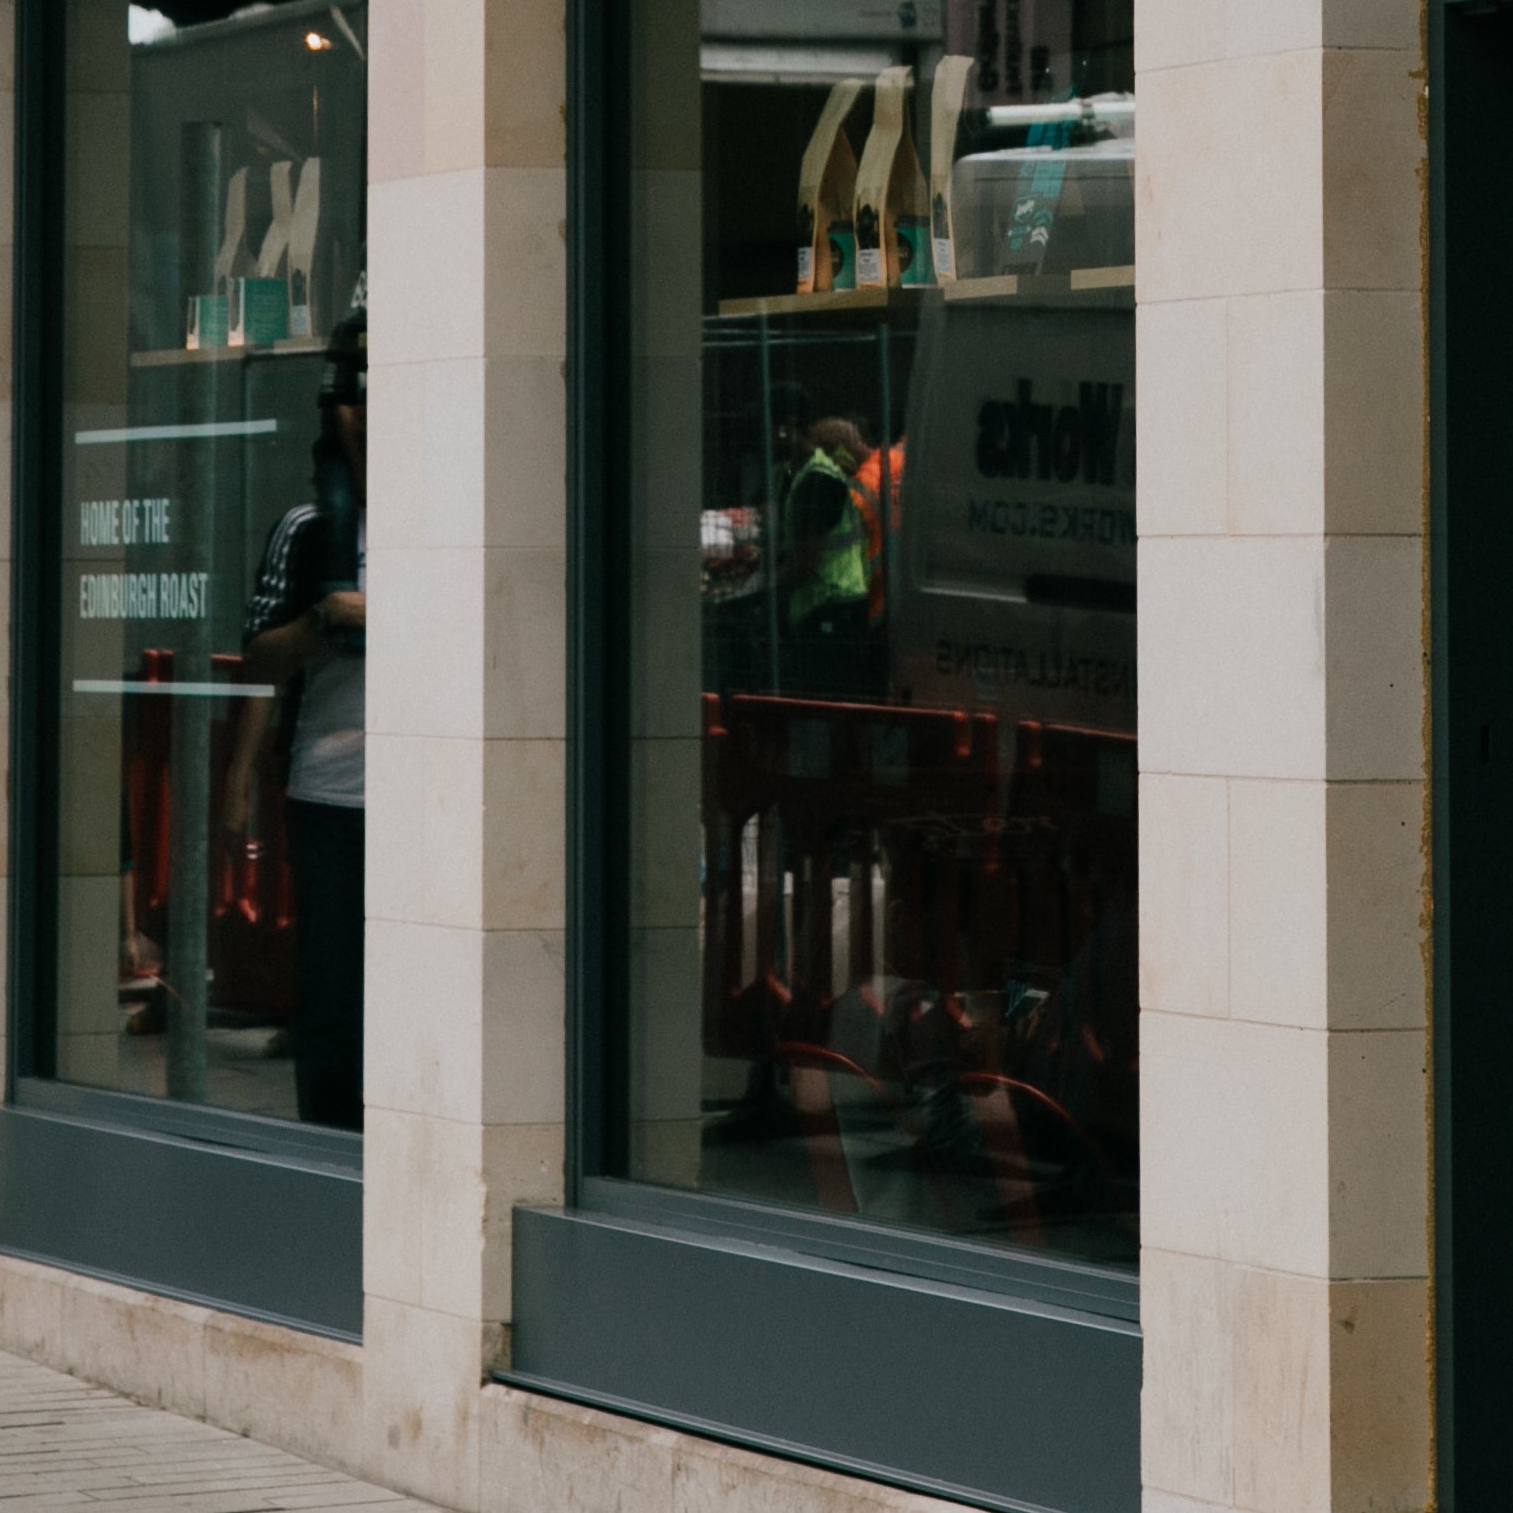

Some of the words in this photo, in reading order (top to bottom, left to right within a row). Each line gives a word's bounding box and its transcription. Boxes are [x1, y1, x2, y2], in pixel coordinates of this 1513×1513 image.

[80, 501, 119, 545] HOME
[122, 500, 140, 544] OF
[142, 498, 170, 543] THE
[80, 573, 157, 619] EDINBURGH
[160, 572, 208, 618] ROAST
